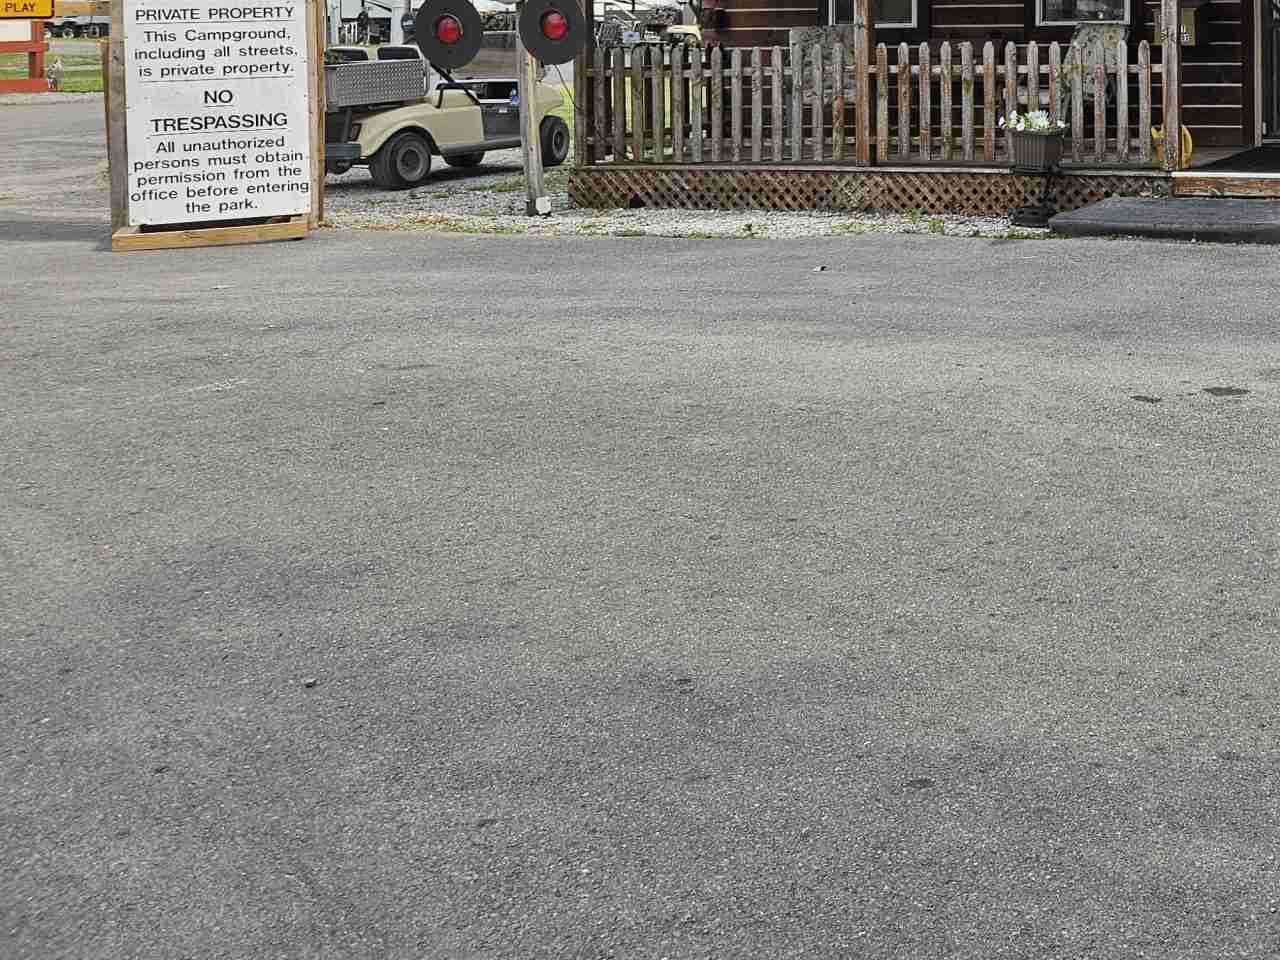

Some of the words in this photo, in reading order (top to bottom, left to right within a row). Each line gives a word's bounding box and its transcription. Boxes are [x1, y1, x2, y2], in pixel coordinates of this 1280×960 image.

[5, 2, 36, 13] PLAY
[135, 8, 200, 21] PRIVATE
[208, 6, 295, 20] PROPERTY
[144, 30, 177, 42] This
[134, 47, 206, 61] including
[214, 46, 230, 57] all
[138, 65, 152, 78] is
[160, 63, 215, 78] private
[223, 61, 294, 76] property.
[204, 89, 233, 104] NO
[150, 112, 288, 133] TRESPASSING
[156, 141, 175, 153] All
[183, 136, 285, 152] unauthorized
[134, 158, 200, 172] persons
[208, 153, 247, 166] must
[255, 151, 303, 164] obtain
[137, 170, 225, 188] permission
[234, 168, 269, 180] from
[278, 165, 302, 177] the
[130, 188, 178, 202] office
[186, 185, 239, 199] before
[247, 180, 309, 194] entering
[186, 201, 211, 213] the
[219, 198, 258, 213] park.
